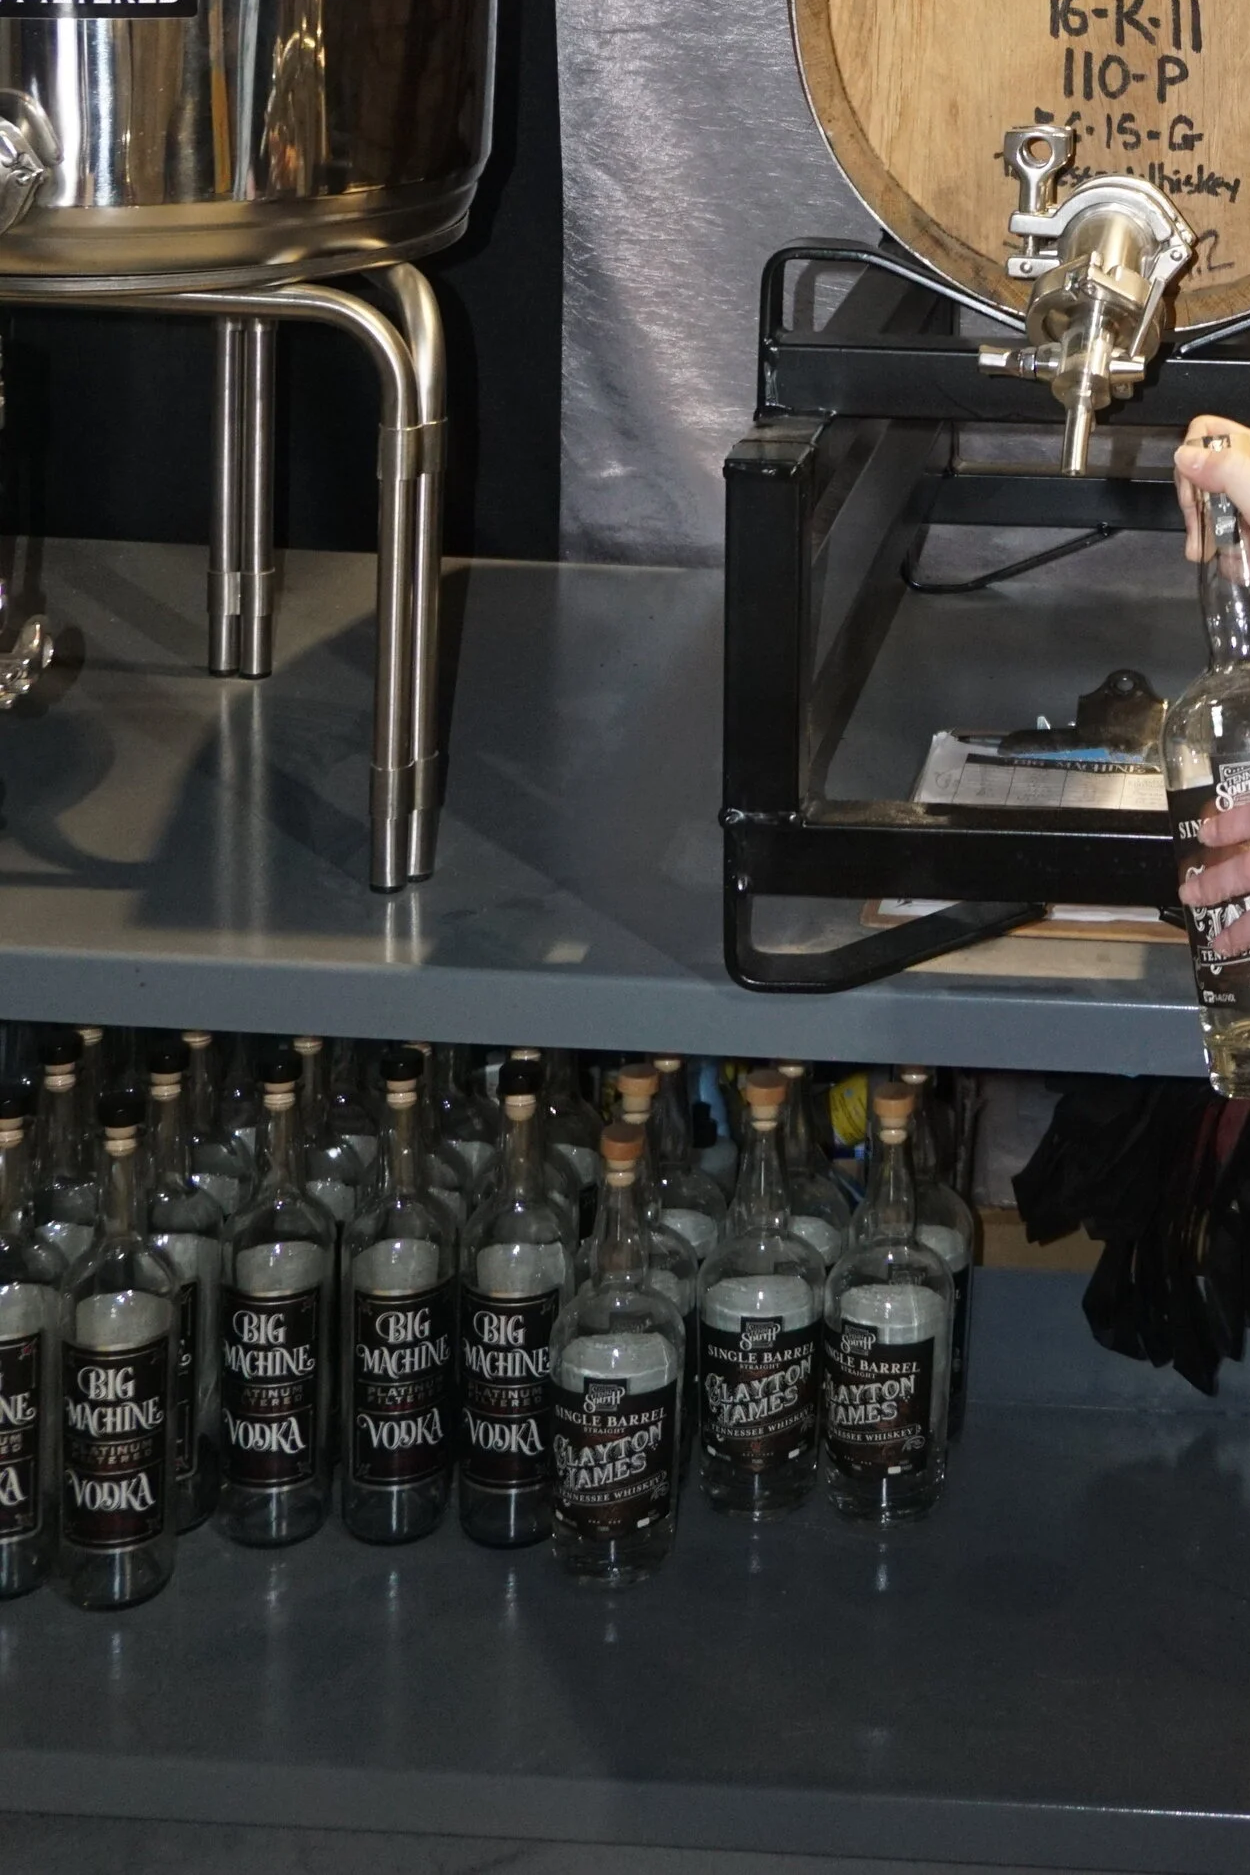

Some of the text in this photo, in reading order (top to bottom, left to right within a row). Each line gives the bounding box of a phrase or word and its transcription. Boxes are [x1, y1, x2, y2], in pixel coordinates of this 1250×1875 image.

[1063, 47, 1190, 104] 110-P
[1178, 818, 1210, 839] SIN
[233, 1310, 288, 1345] BIG
[375, 1307, 432, 1344] BIG
[473, 1310, 527, 1347] BIG
[223, 1338, 317, 1380] MACHINE
[356, 1334, 451, 1380] MACHINE
[462, 1337, 550, 1380] MACHINE
[707, 1341, 816, 1364] SINGLE BARREL
[860, 1360, 921, 1374] BARREL
[77, 1366, 136, 1401] BIG
[705, 1355, 812, 1413] CLAYTON
[65, 1396, 165, 1438] MACHINE
[222, 1408, 307, 1454] VODKA
[356, 1407, 445, 1451] VODKA
[462, 1407, 545, 1457] VODKA
[555, 1404, 667, 1427] SINGLE BARREL
[866, 1428, 914, 1442] WHISKEY
[553, 1421, 663, 1475] CLAYTON
[66, 1469, 157, 1512] VODKA
